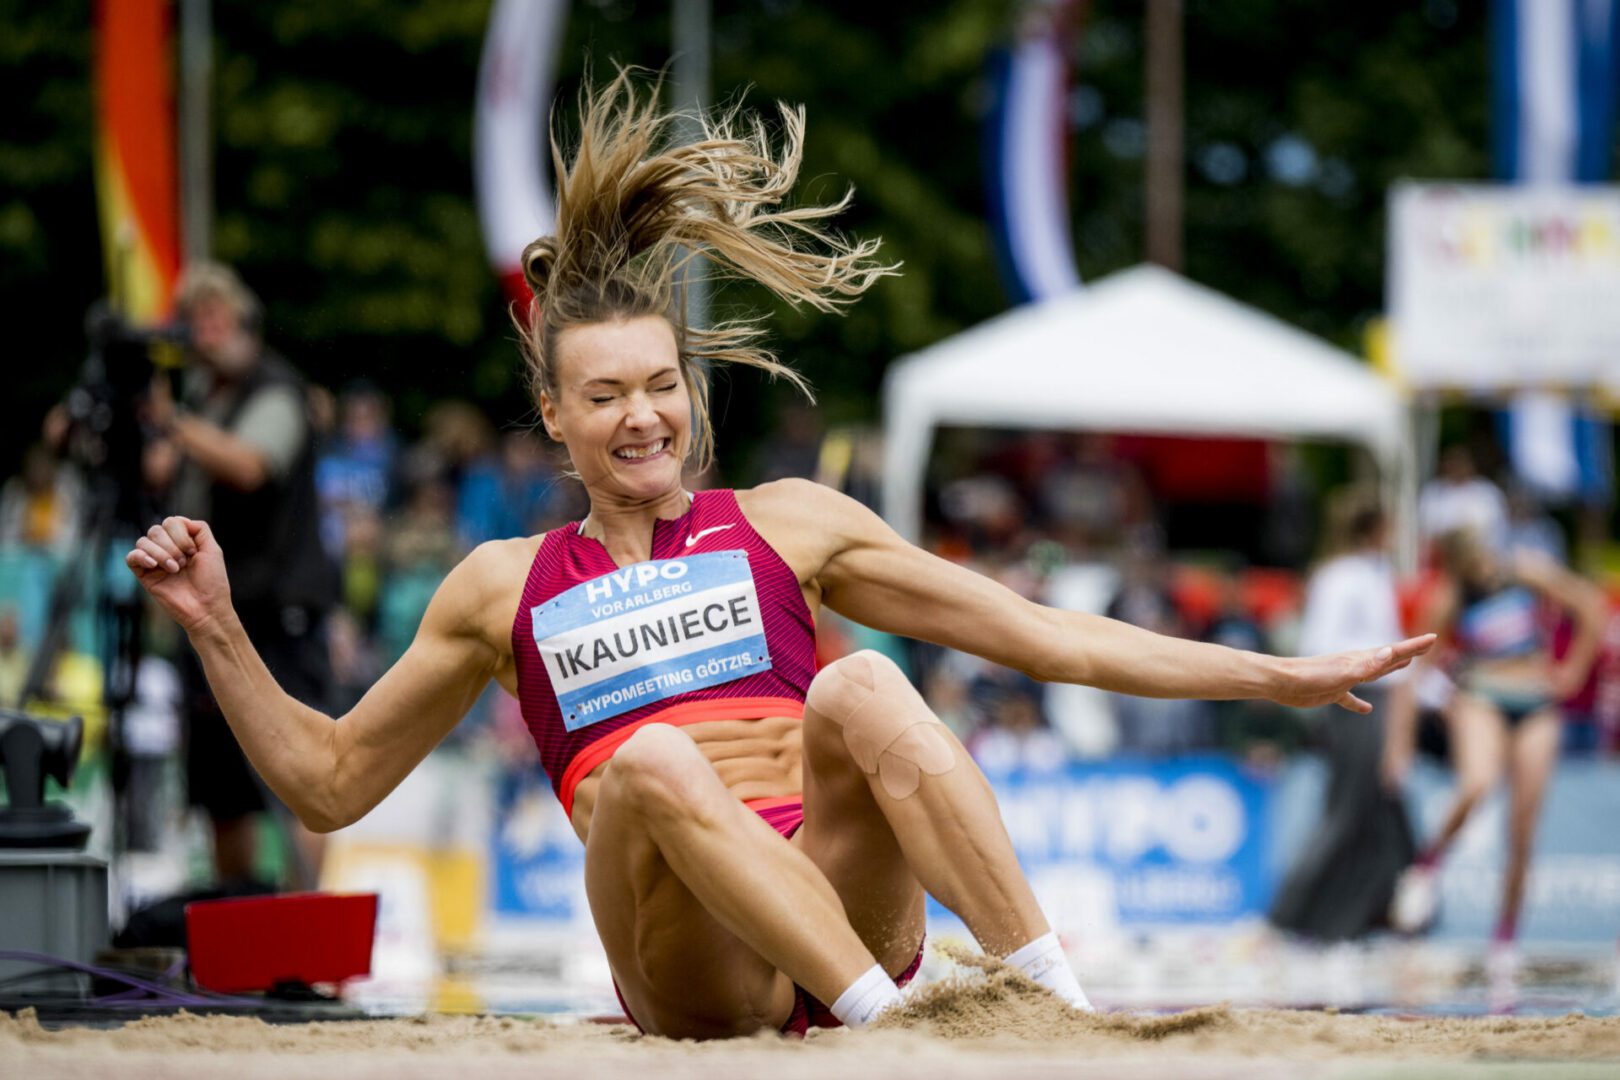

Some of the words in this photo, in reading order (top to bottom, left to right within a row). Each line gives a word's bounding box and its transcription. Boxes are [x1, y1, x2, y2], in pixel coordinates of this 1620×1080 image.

[586, 561, 688, 603] HYPO
[591, 581, 692, 618] VORARLBERG
[554, 595, 752, 679] IKAUNIECE
[580, 669, 694, 715] HYPOMEETING
[696, 652, 752, 678] GÖTZIS
